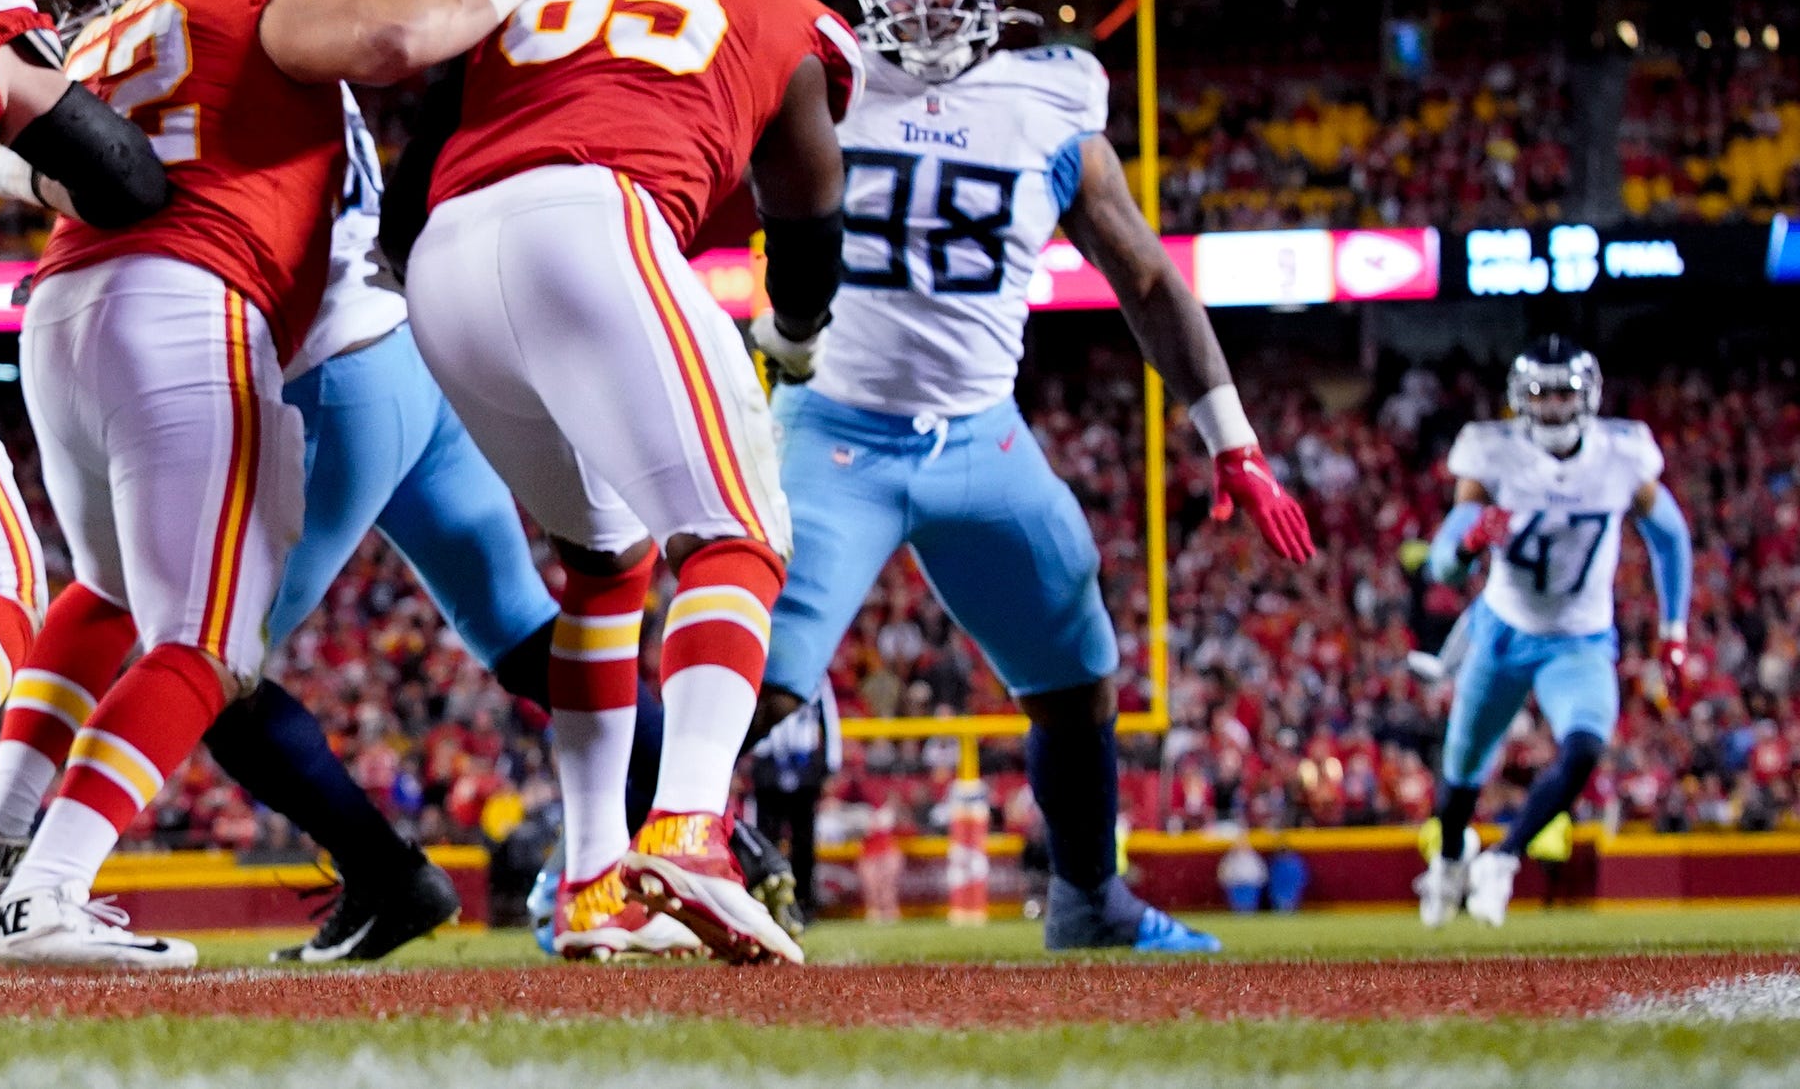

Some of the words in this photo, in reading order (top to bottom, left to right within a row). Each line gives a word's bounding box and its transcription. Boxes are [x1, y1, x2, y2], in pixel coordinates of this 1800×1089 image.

[842, 146, 1022, 295] 98
[1507, 510, 1610, 595] 47
[638, 813, 712, 856] NIKE
